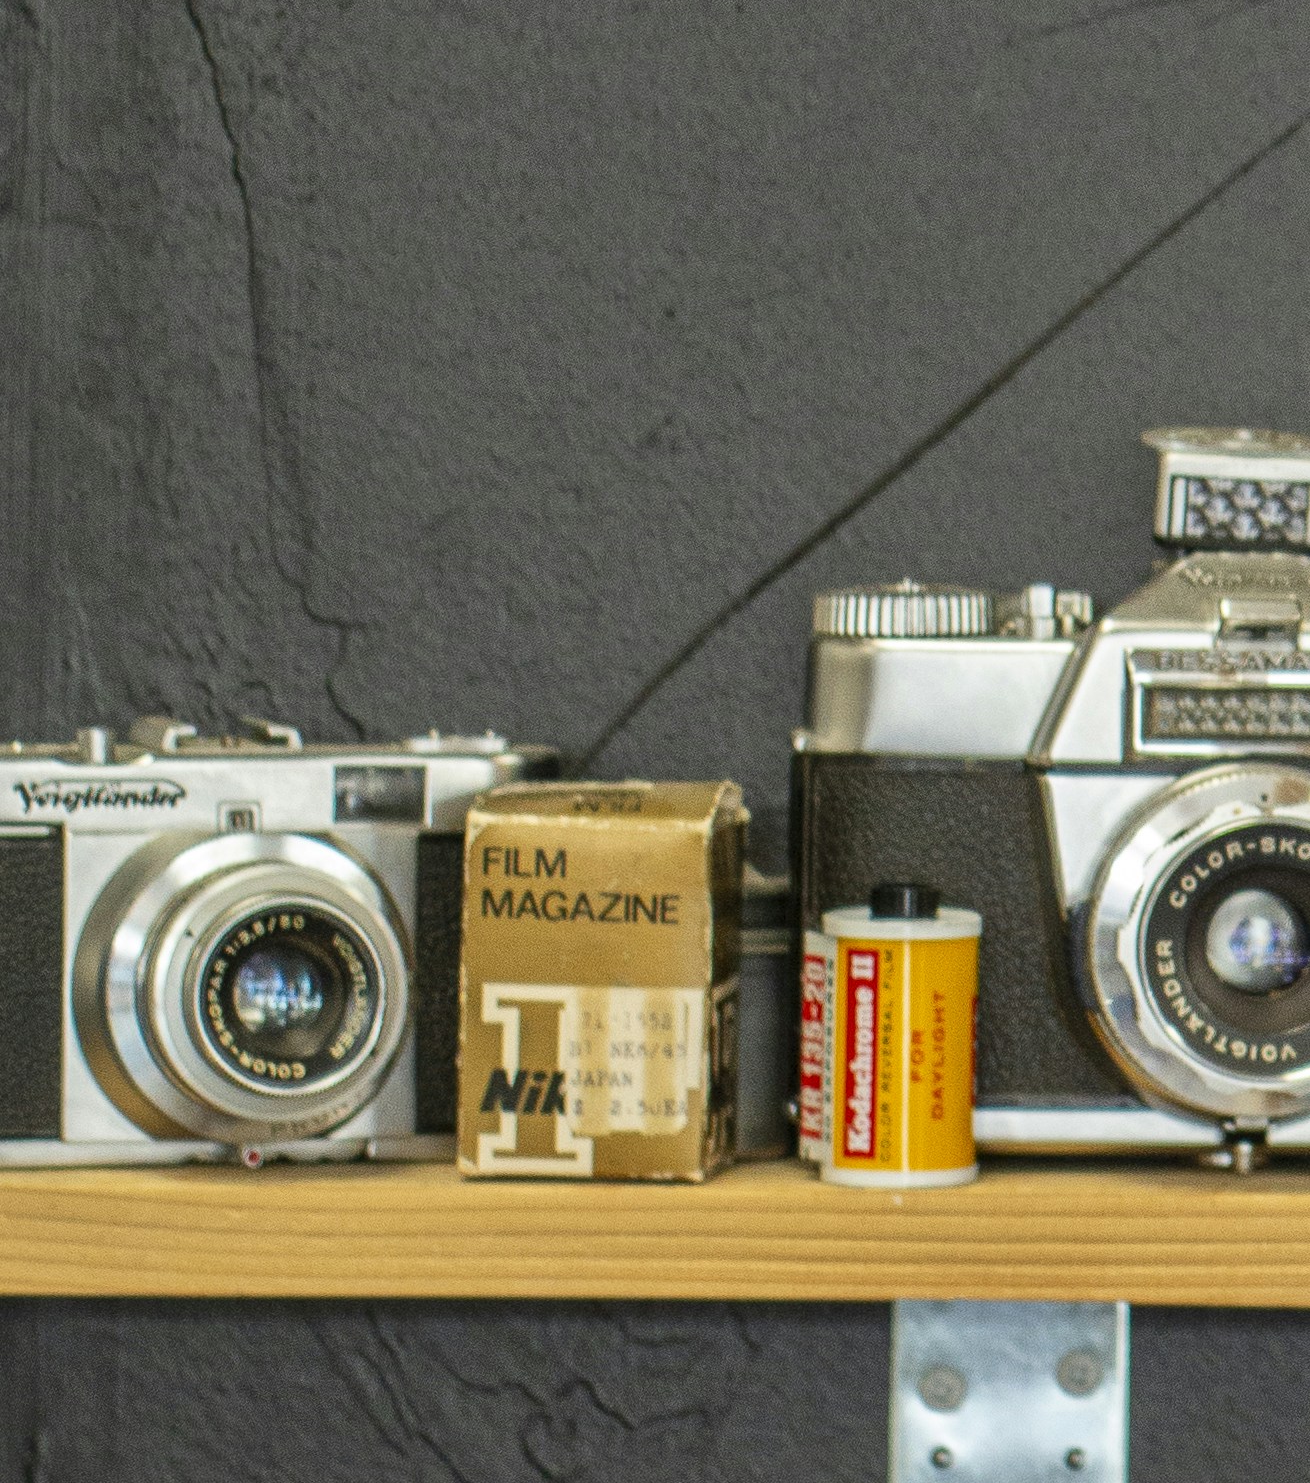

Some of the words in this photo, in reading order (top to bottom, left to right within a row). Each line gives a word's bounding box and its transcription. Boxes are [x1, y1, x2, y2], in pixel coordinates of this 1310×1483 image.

[481, 847, 567, 878] FILM
[481, 888, 680, 924] MAGAZINE
[851, 954, 875, 980] II
[847, 986, 875, 1152] Kodachrome
[911, 1029, 925, 1083] FOR
[931, 990, 945, 1120] DAYLIGHT
